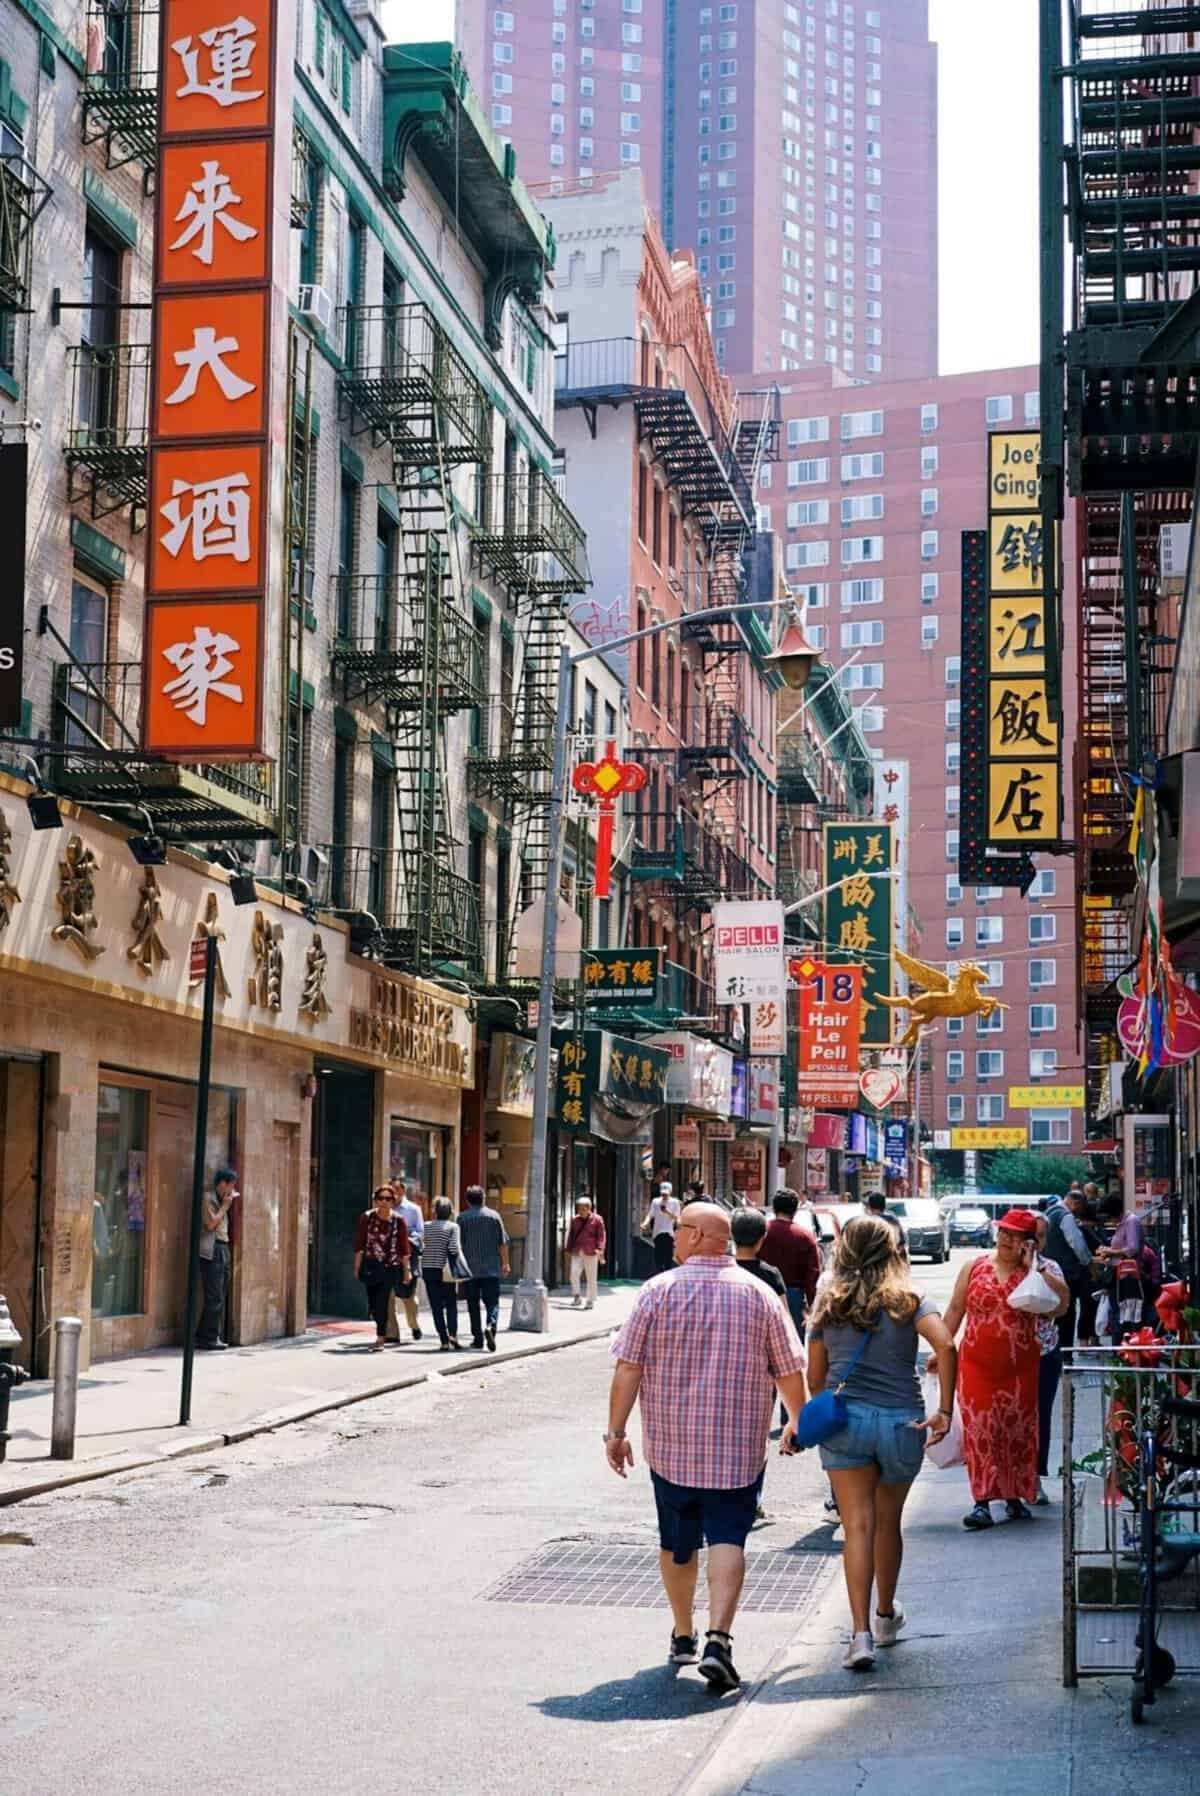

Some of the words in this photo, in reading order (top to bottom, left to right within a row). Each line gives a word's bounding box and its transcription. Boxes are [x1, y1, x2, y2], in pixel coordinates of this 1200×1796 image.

[156, 15, 265, 727] 運來大酒家
[1002, 443, 1041, 464] Joe'
[994, 473, 1041, 499] Ging
[994, 519, 1054, 834] 錦江飯店
[719, 926, 778, 946] PELL
[718, 946, 742, 954] HAIR
[811, 973, 854, 1005] 18
[808, 1013, 848, 1027] Hair
[816, 1028, 840, 1042] Le
[811, 1046, 847, 1060] Pell
[814, 1094, 839, 1104] PELL
